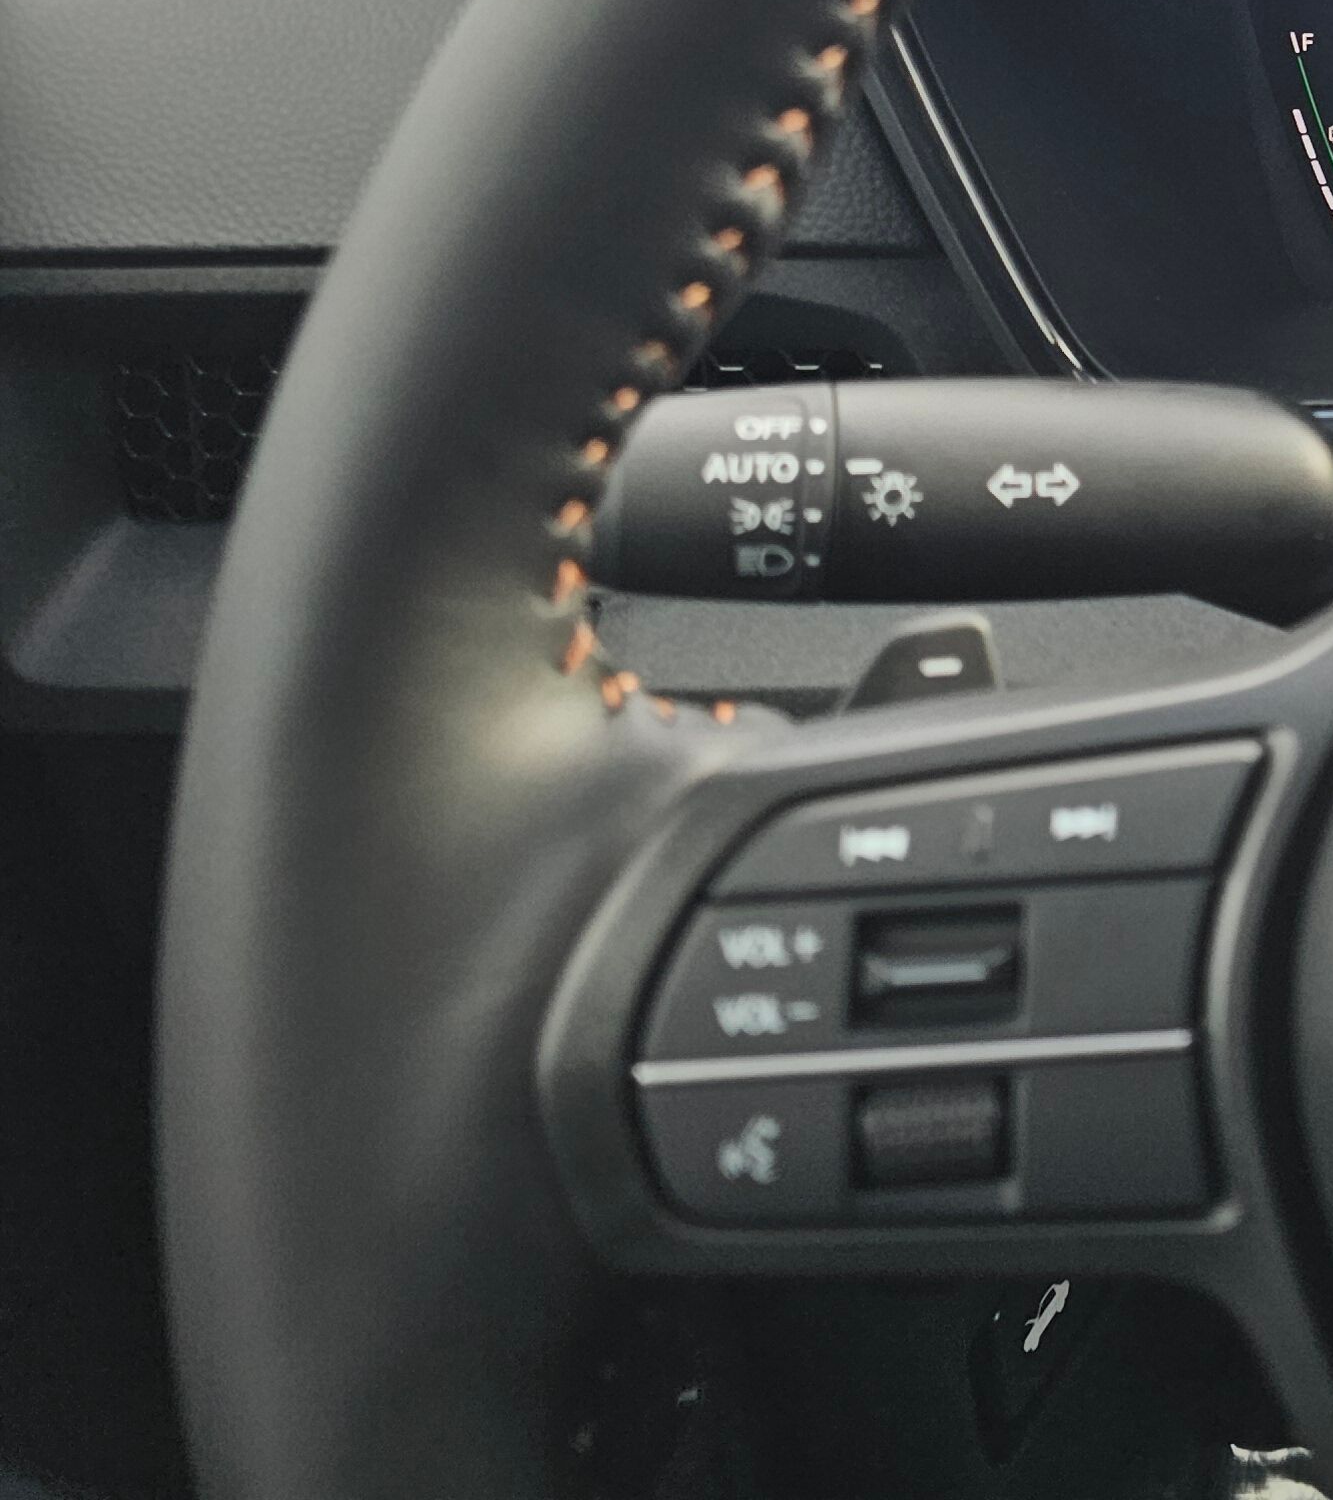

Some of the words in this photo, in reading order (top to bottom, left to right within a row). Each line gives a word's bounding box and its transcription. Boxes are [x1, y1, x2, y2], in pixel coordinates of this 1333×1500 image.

[1302, 33, 1315, 51] F
[735, 416, 801, 441] OFF
[702, 454, 798, 484] AUTO
